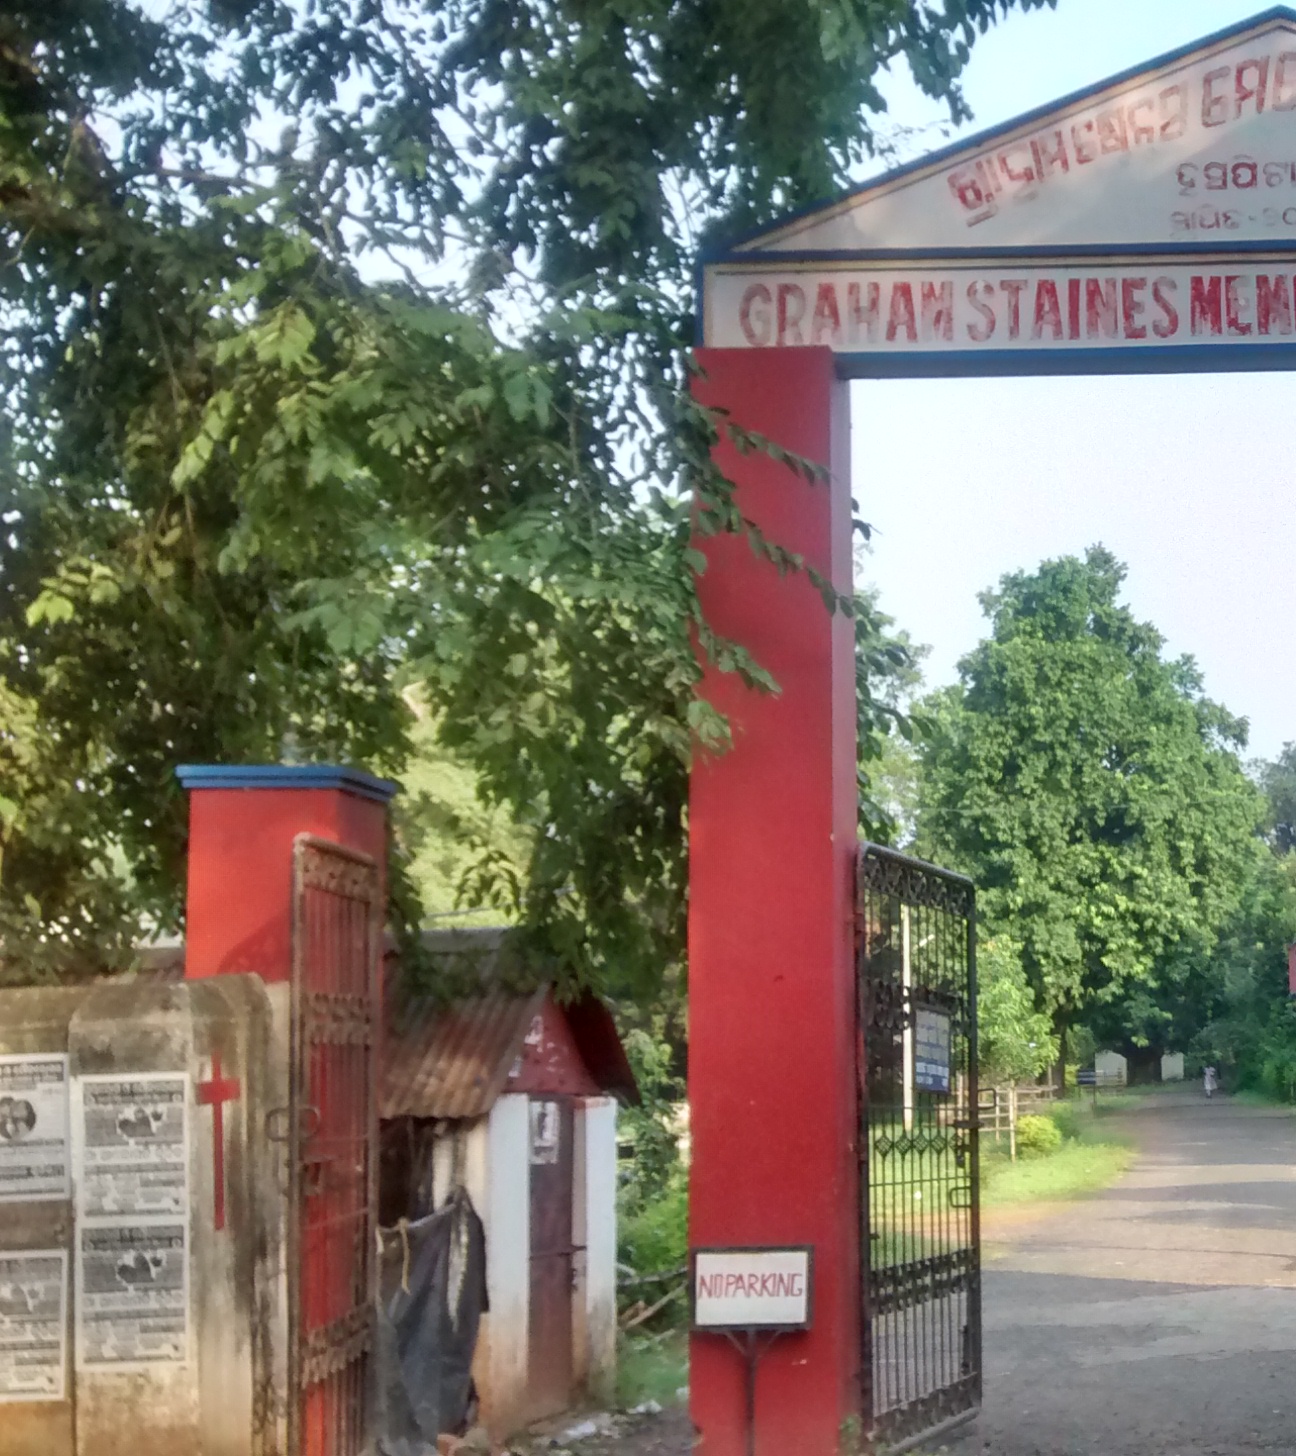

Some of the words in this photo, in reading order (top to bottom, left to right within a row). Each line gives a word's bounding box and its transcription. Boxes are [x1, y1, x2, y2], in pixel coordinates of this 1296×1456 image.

[739, 281, 954, 347] GRAHAM
[966, 277, 1179, 342] STAINES
[699, 1273, 723, 1298] NO
[724, 1272, 803, 1298] PARKING
